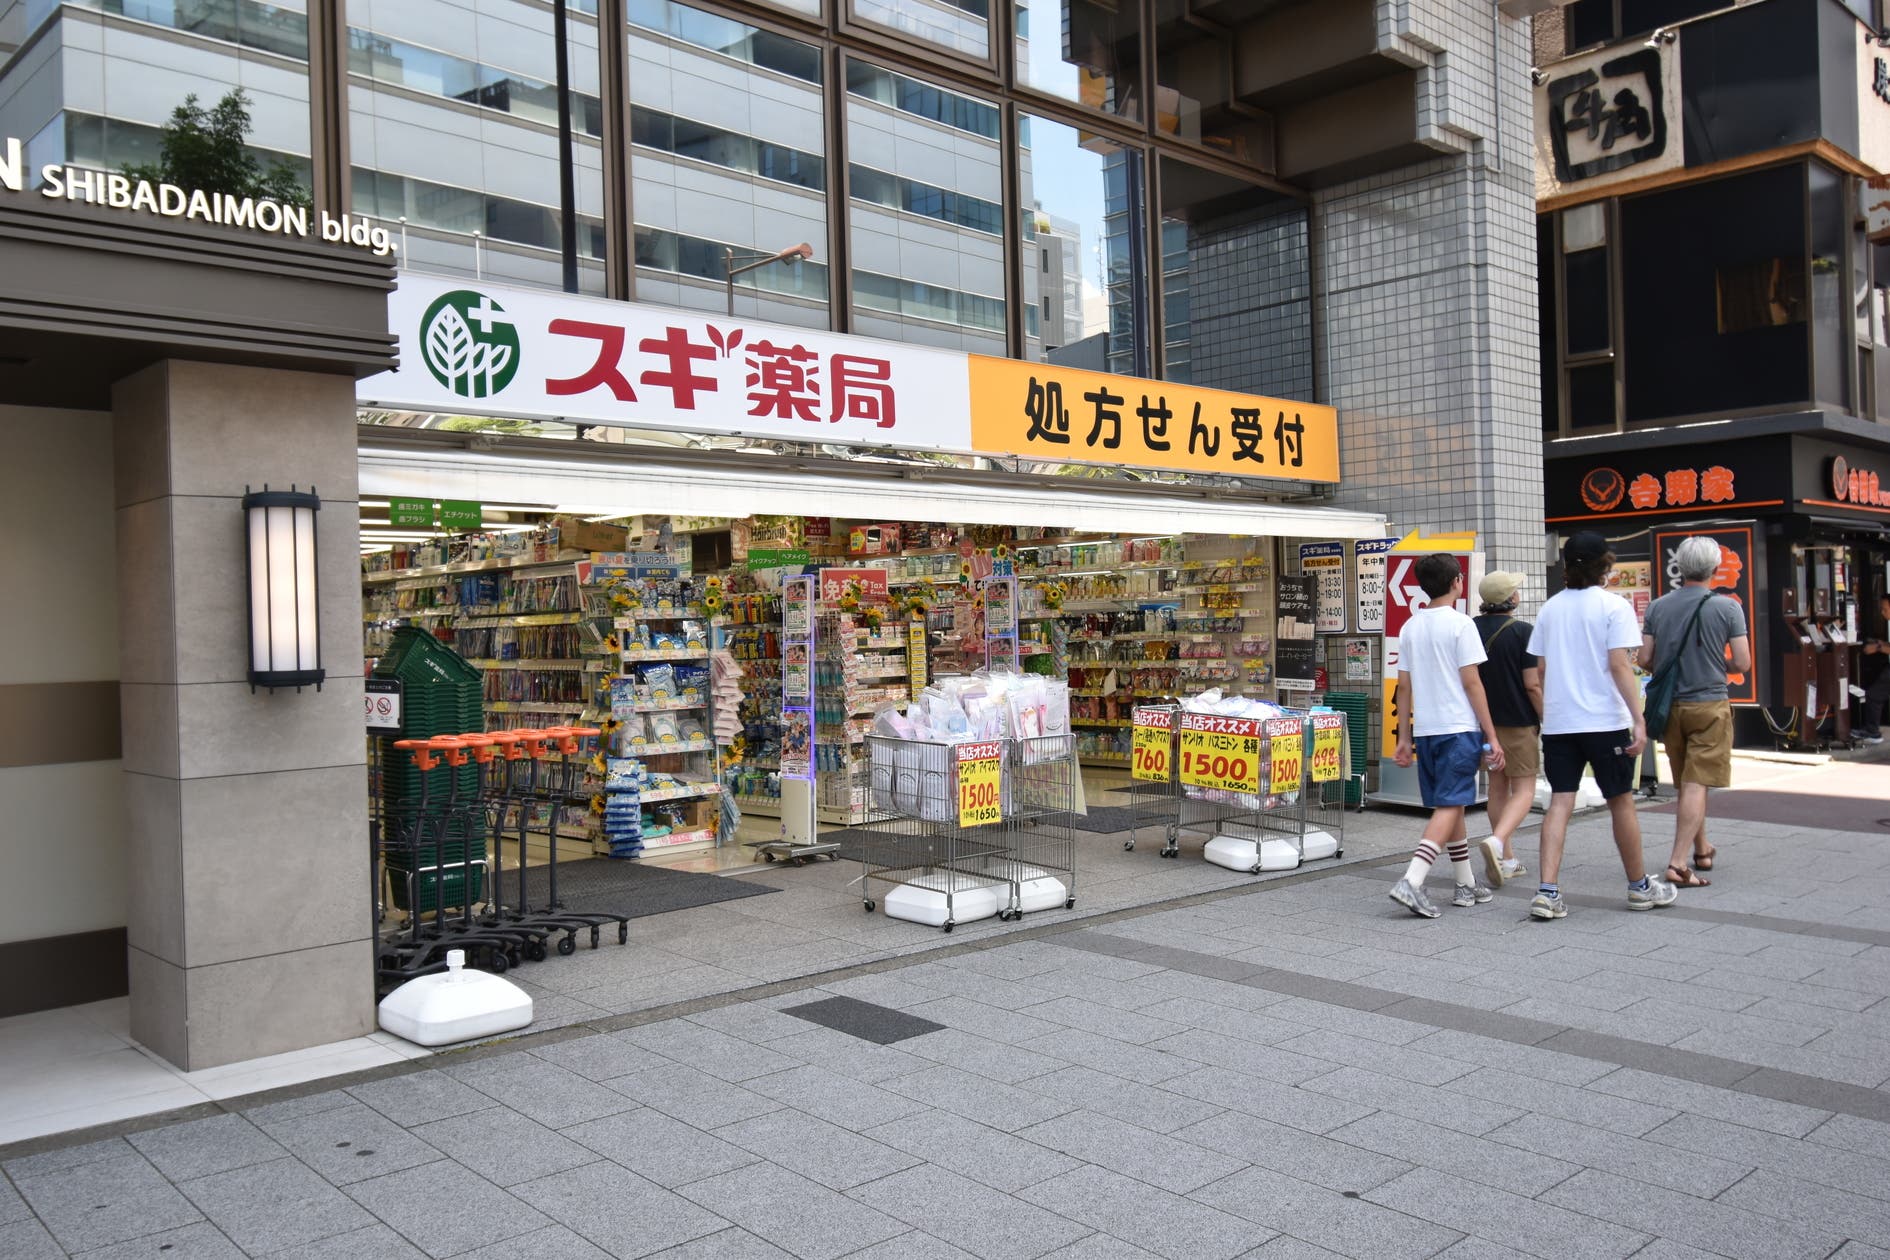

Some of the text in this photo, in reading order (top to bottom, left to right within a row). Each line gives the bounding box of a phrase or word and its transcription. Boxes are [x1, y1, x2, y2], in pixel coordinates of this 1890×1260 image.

[1565, 88, 1652, 150] 牛角
[41, 164, 308, 236] SHIBADAIMON
[321, 210, 398, 256] bldg.
[545, 318, 896, 428] スギ薬局
[1025, 376, 1304, 467] 処方せん受付
[1628, 466, 1736, 509] 吉野家
[444, 511, 477, 520] エチケット
[751, 525, 788, 541] Hairbrush
[1303, 558, 1340, 567] 処方せん受付
[870, 581, 884, 589] Tax
[1133, 711, 1171, 728] 当店オススメ
[958, 745, 999, 760] 当店オススメ
[1183, 732, 1205, 747] サンリオ
[1243, 738, 1258, 755] 各種
[979, 759, 1000, 774] アイマスク
[1183, 752, 1257, 783] 1500円
